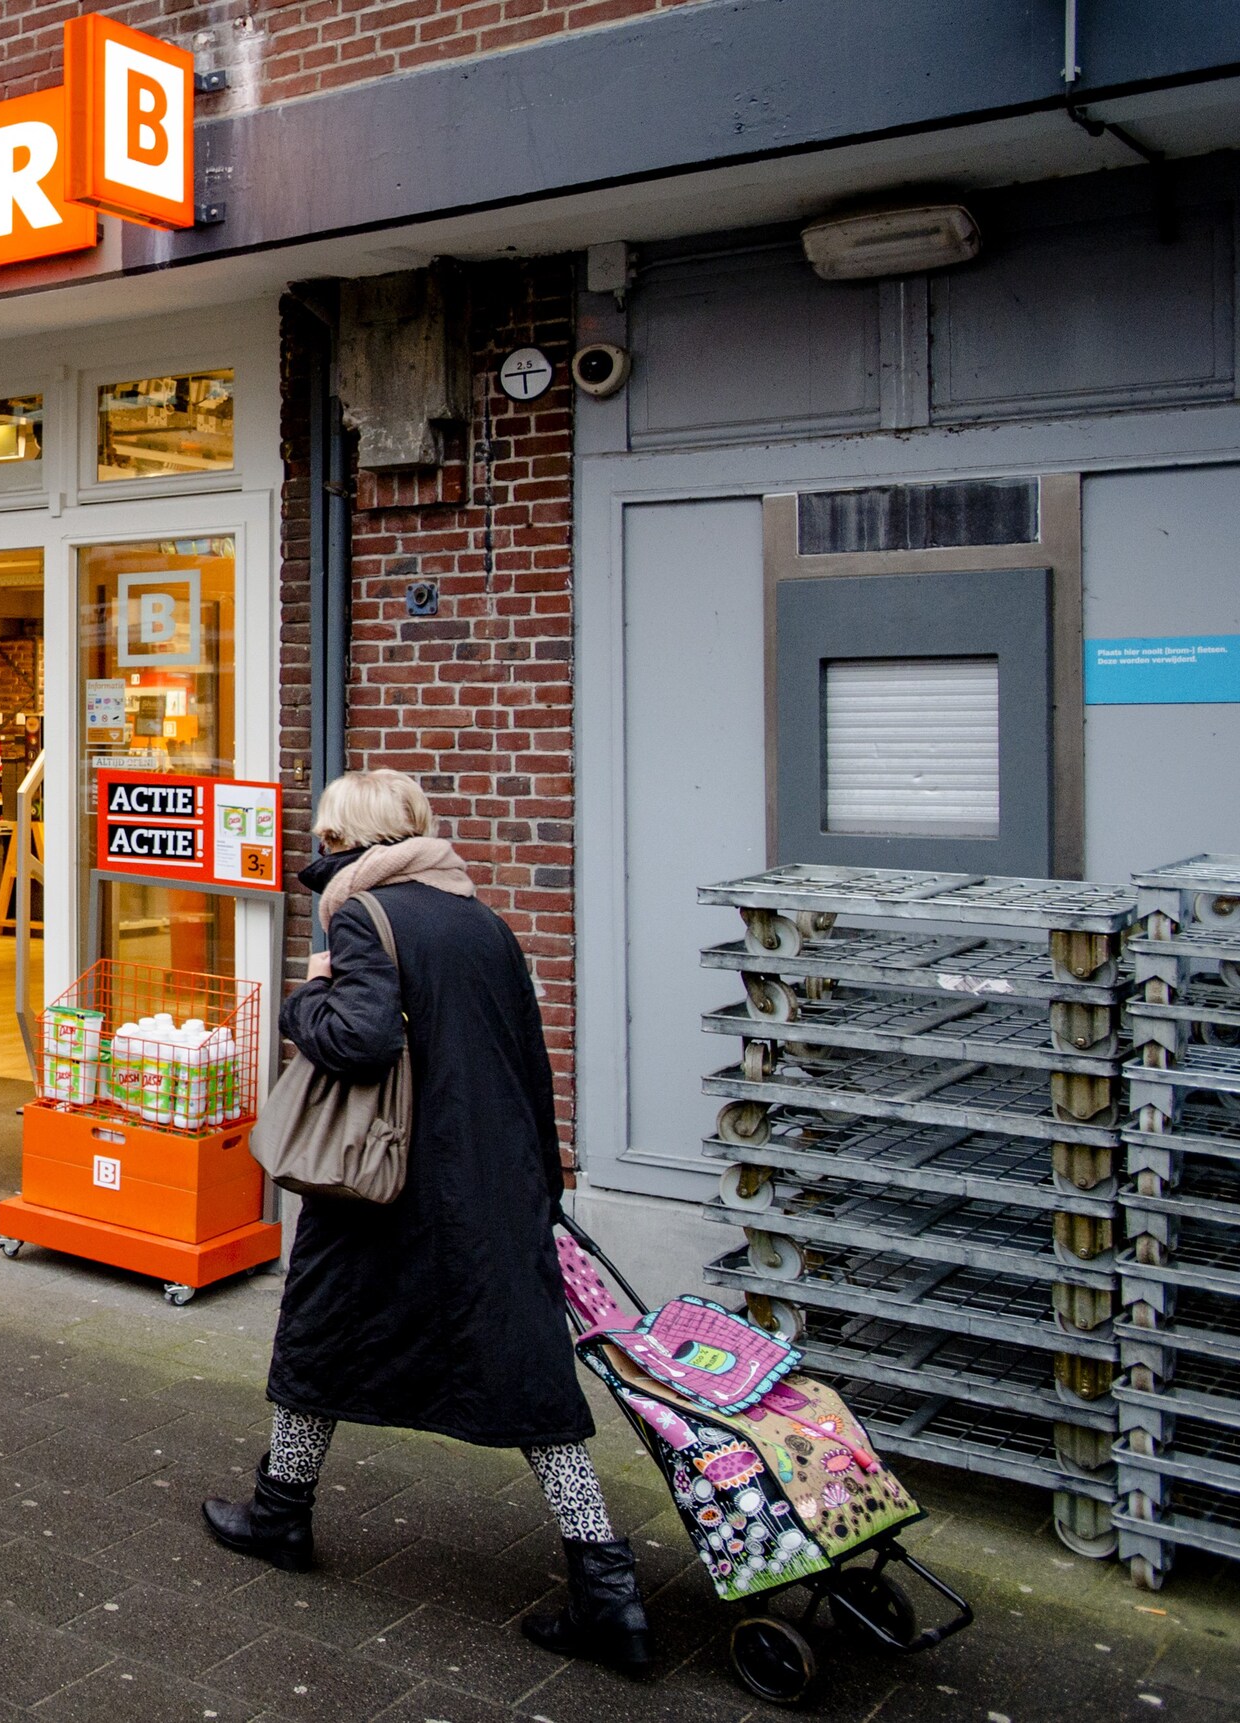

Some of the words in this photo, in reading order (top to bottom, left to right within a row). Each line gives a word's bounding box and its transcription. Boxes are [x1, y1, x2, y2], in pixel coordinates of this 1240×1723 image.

[127, 67, 169, 167] B
[517, 361, 533, 370] 2.5
[141, 593, 176, 643] B
[1124, 648, 1139, 656] hier
[109, 785, 204, 815] ACTIE!
[109, 827, 204, 858] ACTIE!
[100, 1161, 115, 1183] B
